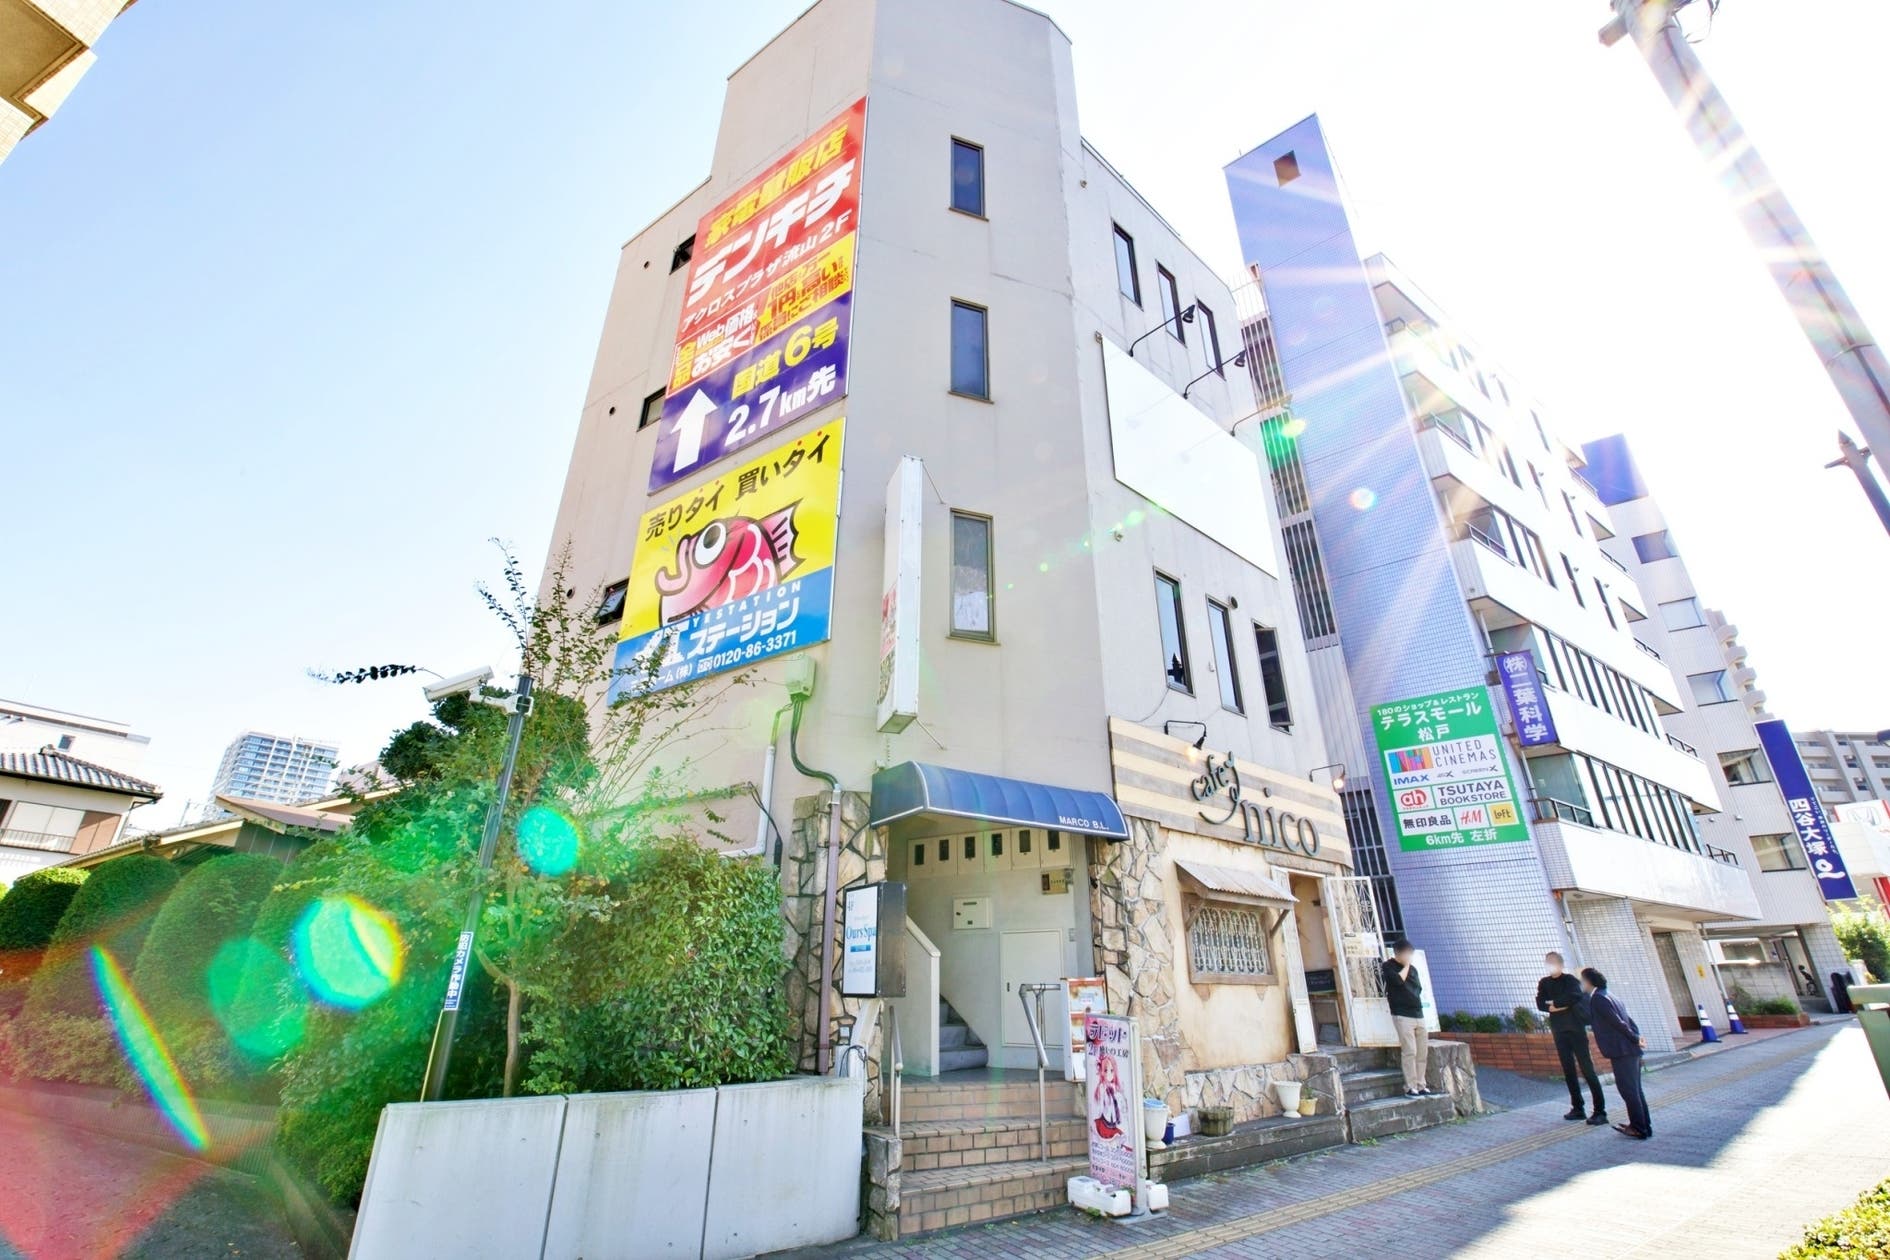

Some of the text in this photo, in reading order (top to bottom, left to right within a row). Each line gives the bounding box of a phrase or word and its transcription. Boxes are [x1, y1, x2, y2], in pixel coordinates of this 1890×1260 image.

[688, 157, 856, 307] デンキチ
[645, 434, 830, 541] 売りタイ 買いタイ
[693, 581, 801, 628] YESTATION
[713, 630, 796, 668] 0120-86-3371
[1380, 702, 1482, 731] テラスモール
[1417, 724, 1450, 742] 松戸
[1432, 739, 1482, 756] UNITED
[1435, 749, 1497, 768] CINEMAS
[1393, 774, 1430, 786] IMAX
[1437, 779, 1504, 797] TSUTAYA
[1440, 791, 1507, 807] BOOKSTORE
[1059, 815, 1090, 827] MARCO
[1240, 787, 1320, 856] nico
[1403, 815, 1452, 829] 無印良品
[1788, 798, 1829, 856] 四谷大塚
